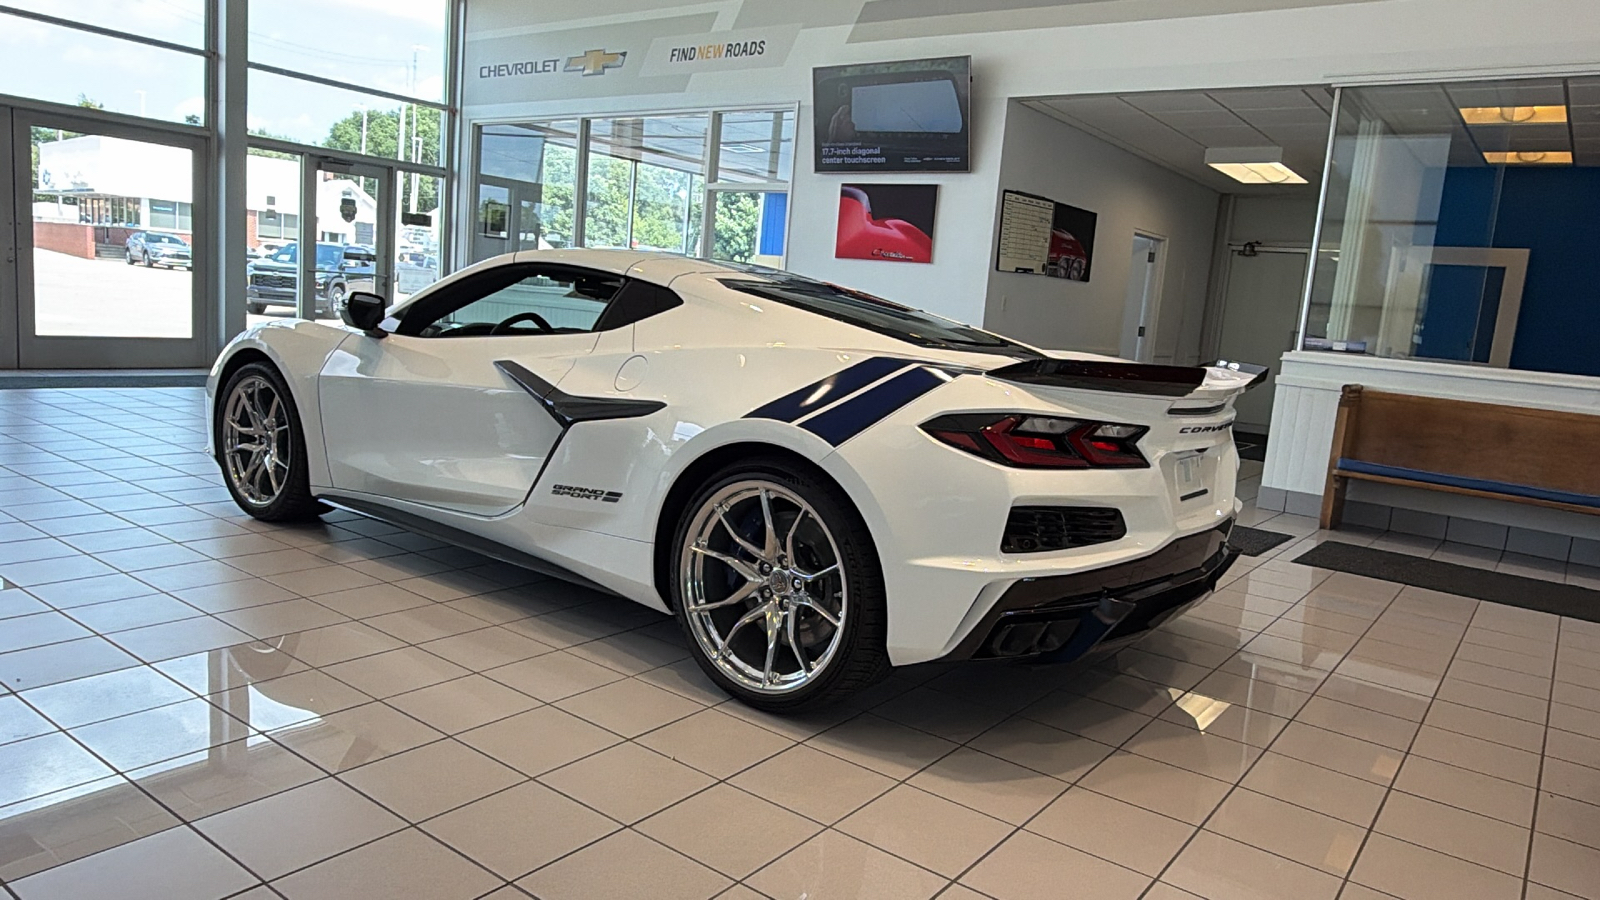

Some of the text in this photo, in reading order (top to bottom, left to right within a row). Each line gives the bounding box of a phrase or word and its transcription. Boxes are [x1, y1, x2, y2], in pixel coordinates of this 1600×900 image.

[670, 40, 766, 63] FIND NEW ROADS
[479, 59, 560, 78] CHEVROLET
[822, 146, 881, 156] 17.7-inch diagonal
[844, 155, 886, 164] touchscreen
[551, 489, 602, 501] SPORT
[552, 484, 605, 496] GRAND
